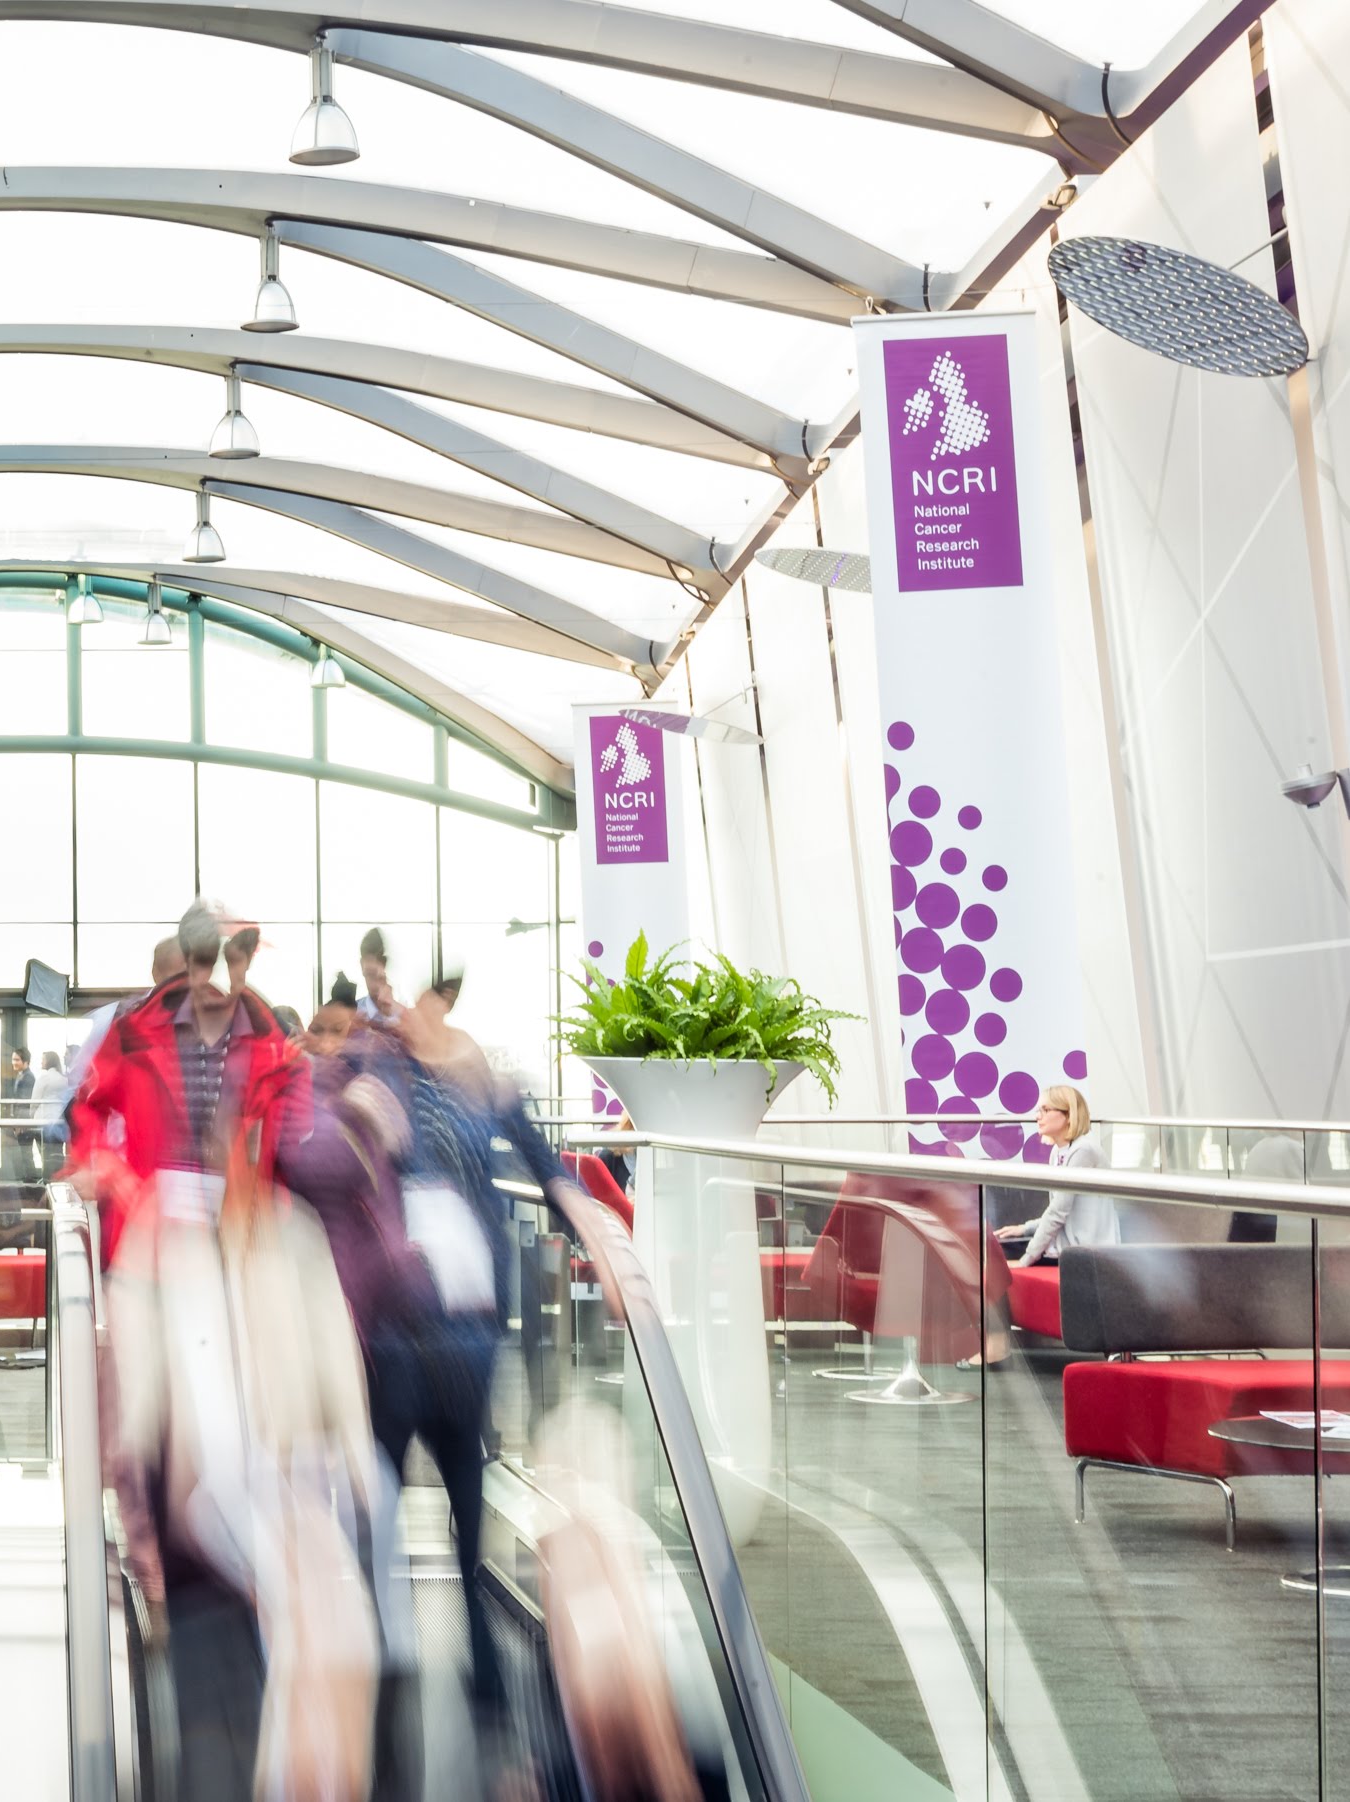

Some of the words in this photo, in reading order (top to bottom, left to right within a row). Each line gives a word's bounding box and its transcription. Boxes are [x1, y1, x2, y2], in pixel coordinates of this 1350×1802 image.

[912, 466, 997, 497] NCRI
[914, 503, 970, 518] National
[914, 522, 962, 536] Cancer
[916, 538, 980, 553] Research
[918, 556, 975, 571] Institute
[604, 791, 655, 809] NCRI
[605, 812, 639, 822] National
[605, 823, 634, 832] Cancer
[606, 833, 644, 842] Research
[607, 844, 641, 853] Institute
